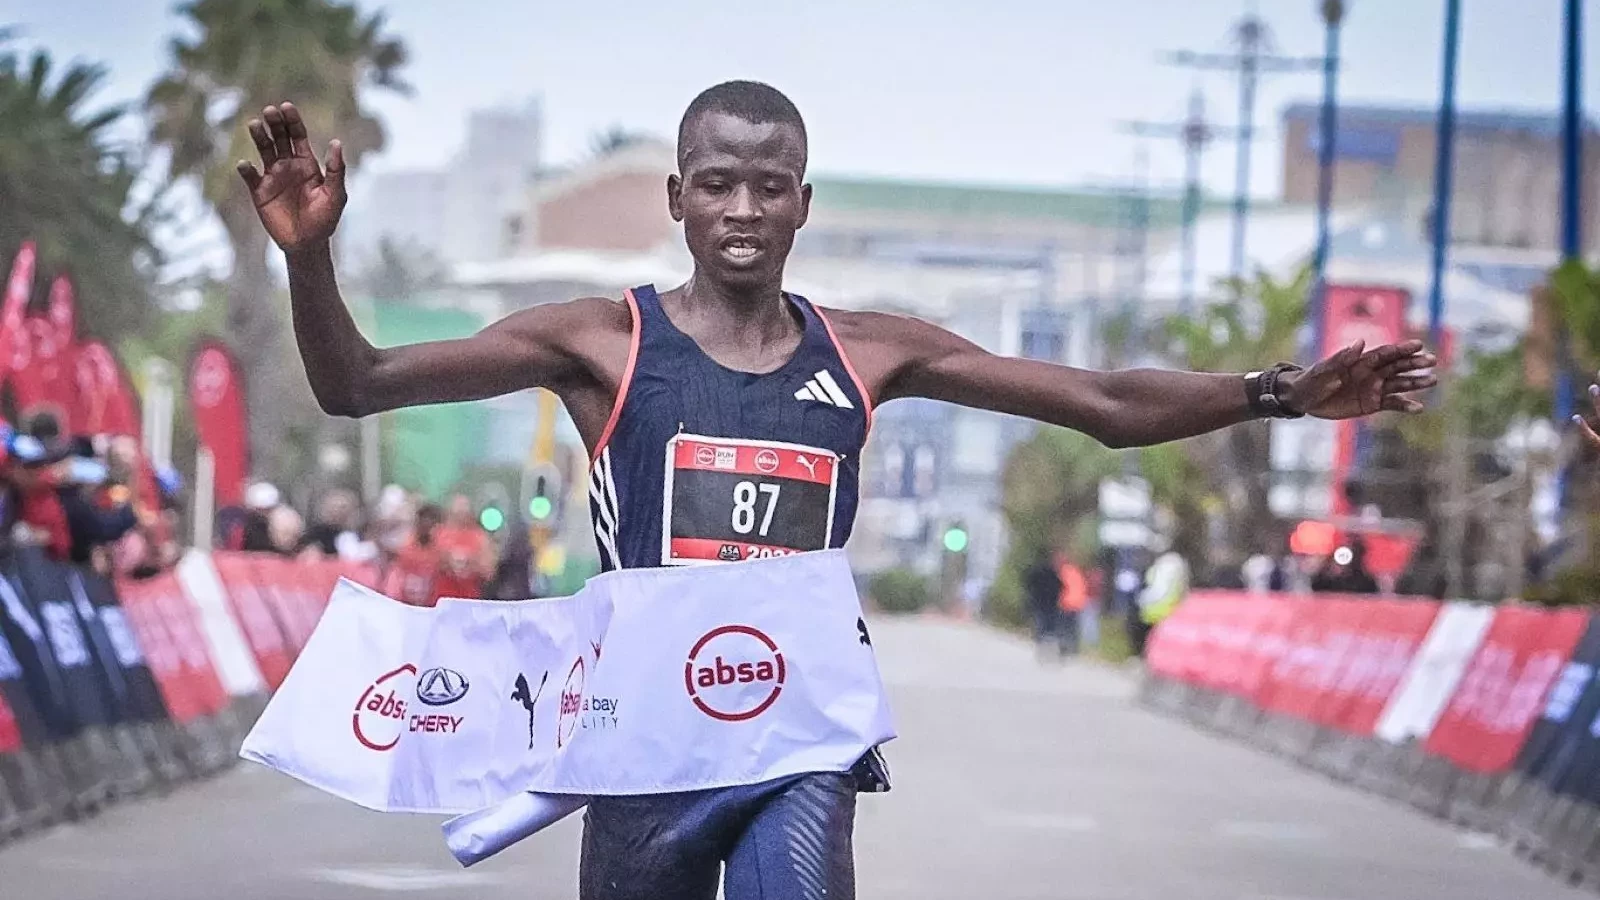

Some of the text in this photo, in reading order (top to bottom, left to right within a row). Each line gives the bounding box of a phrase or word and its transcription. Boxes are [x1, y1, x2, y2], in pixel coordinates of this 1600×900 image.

[732, 481, 781, 537] 87
[698, 656, 774, 688] absa
[592, 694, 618, 715] bay
[409, 715, 464, 733] CHERY
